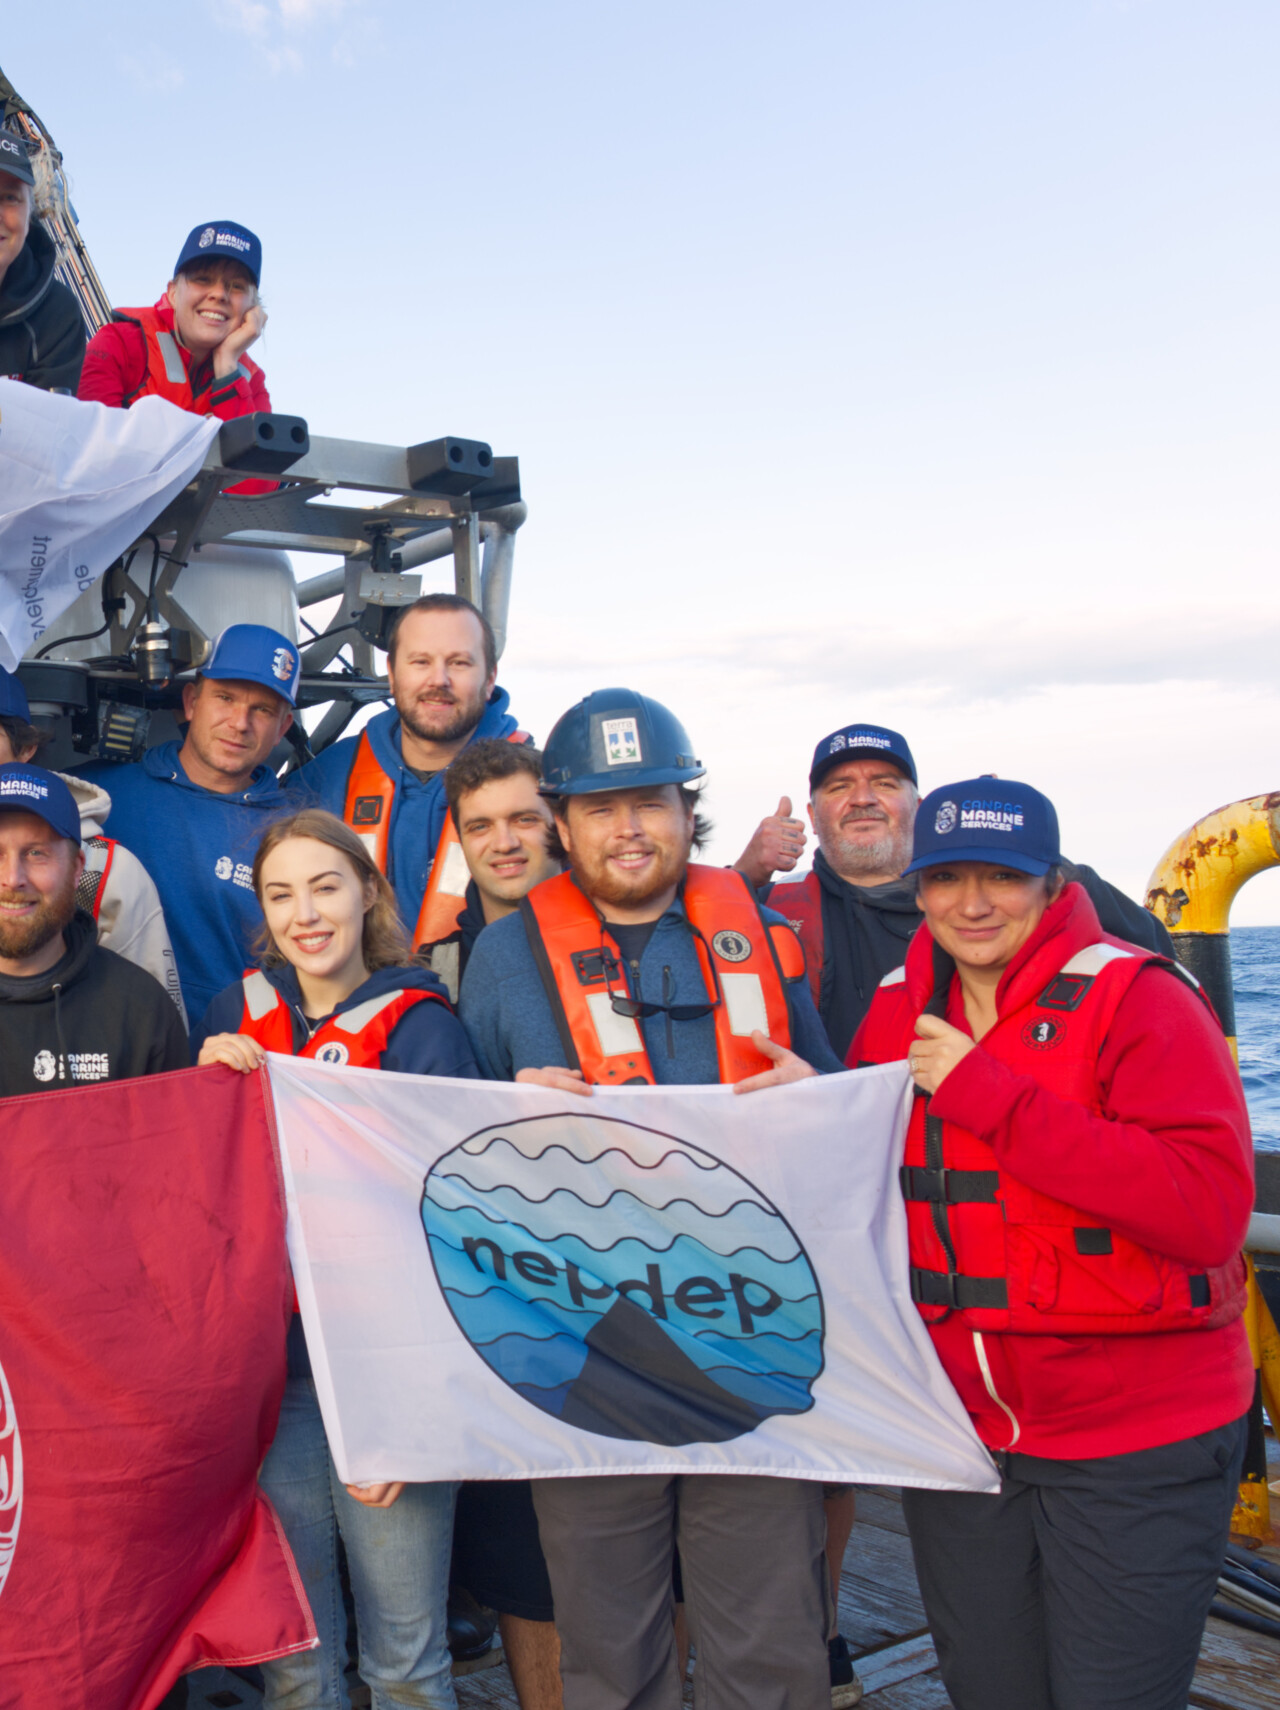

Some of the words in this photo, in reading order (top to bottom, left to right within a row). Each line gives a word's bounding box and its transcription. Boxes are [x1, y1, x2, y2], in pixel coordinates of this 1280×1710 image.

[216, 233, 251, 251] MARINE
[847, 736, 891, 748] MARINE
[0, 780, 48, 797] MARINE
[0, 789, 40, 800] SERVICES
[961, 799, 1023, 814] CANPAC
[960, 810, 1024, 826] MARINE
[960, 820, 1012, 832] SERVICES
[461, 1236, 783, 1334] nepdep
